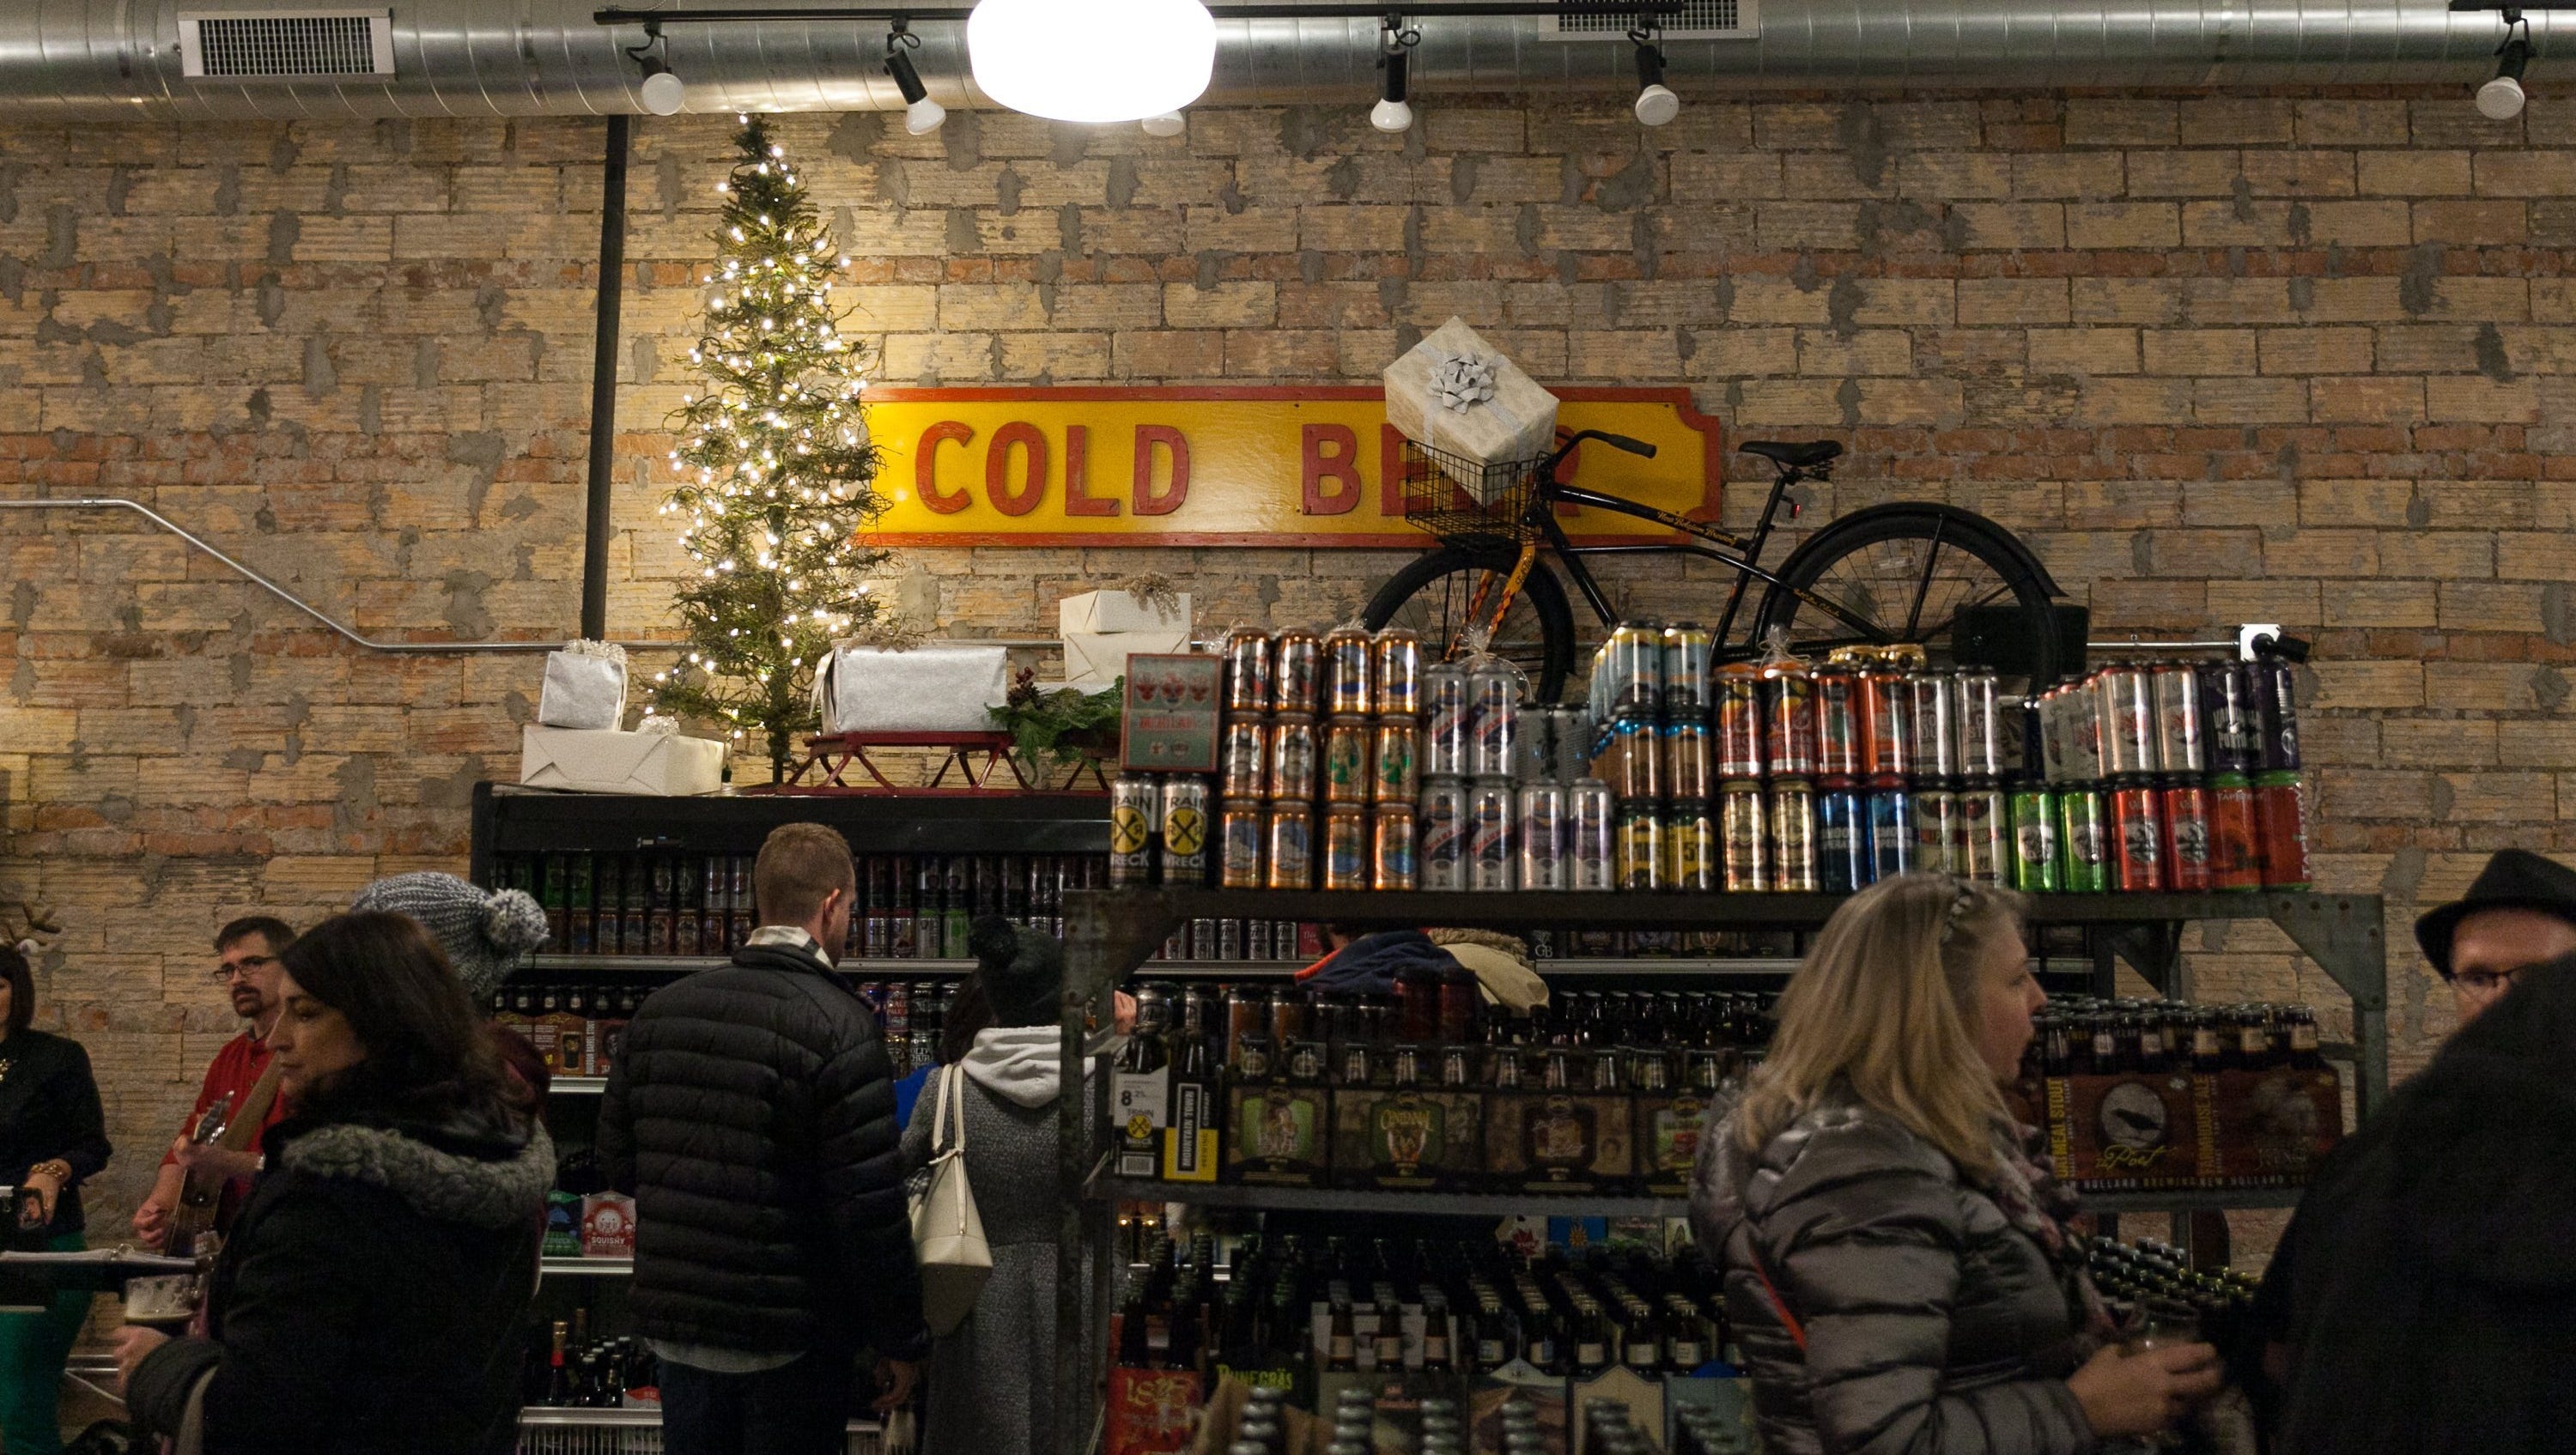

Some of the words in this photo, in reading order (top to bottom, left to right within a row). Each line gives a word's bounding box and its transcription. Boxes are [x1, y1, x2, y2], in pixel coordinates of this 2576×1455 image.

[915, 421, 1190, 516] COLD
[1113, 795, 1153, 812] RAIN
[1112, 849, 1150, 868] RECK
[1534, 944, 1552, 958] GB
[1183, 1089, 1196, 1118] TOWN
[2046, 1076, 2065, 1119] STOUT
[1182, 1119, 1194, 1167] MOUNTAIN
[2084, 1179, 2137, 1190] HOLLAND
